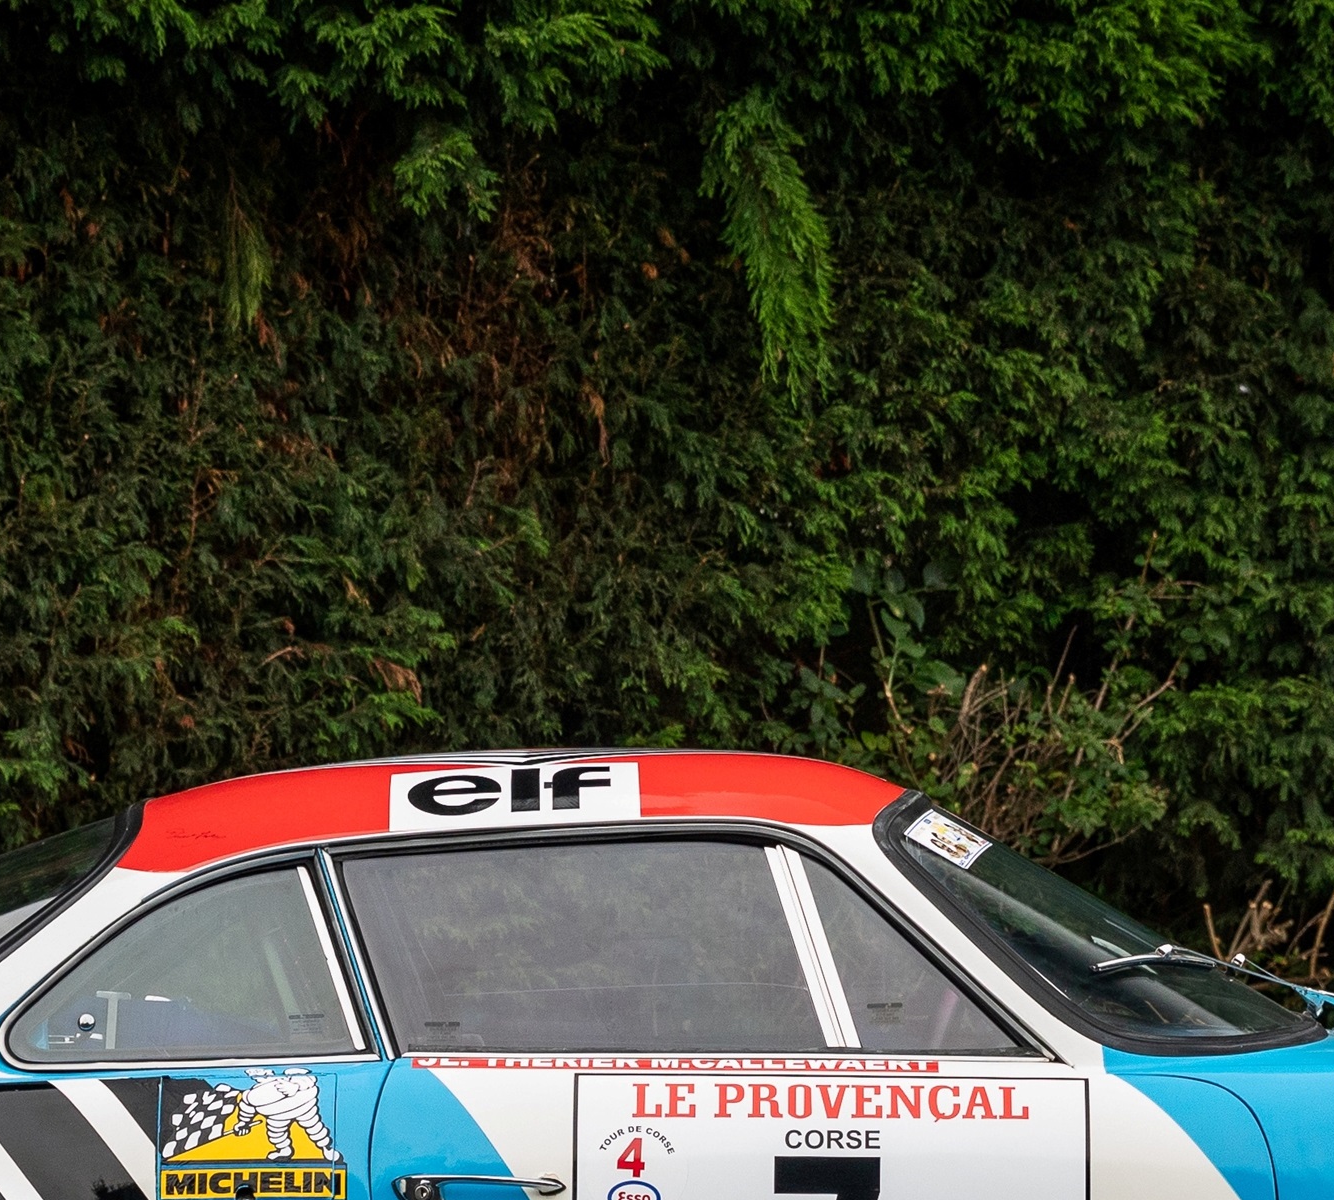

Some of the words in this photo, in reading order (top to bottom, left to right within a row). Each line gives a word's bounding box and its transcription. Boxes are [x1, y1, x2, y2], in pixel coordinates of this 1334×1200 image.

[407, 765, 611, 816] elf
[632, 1083, 697, 1118] LE
[714, 1083, 1029, 1122] PROVENÇAL
[599, 1128, 625, 1152] TOUR
[628, 1125, 642, 1133] DE
[645, 1127, 676, 1155] CORSE
[784, 1129, 882, 1150] CORSE
[616, 1137, 645, 1178] 4
[165, 1171, 341, 1195] MICHELIN
